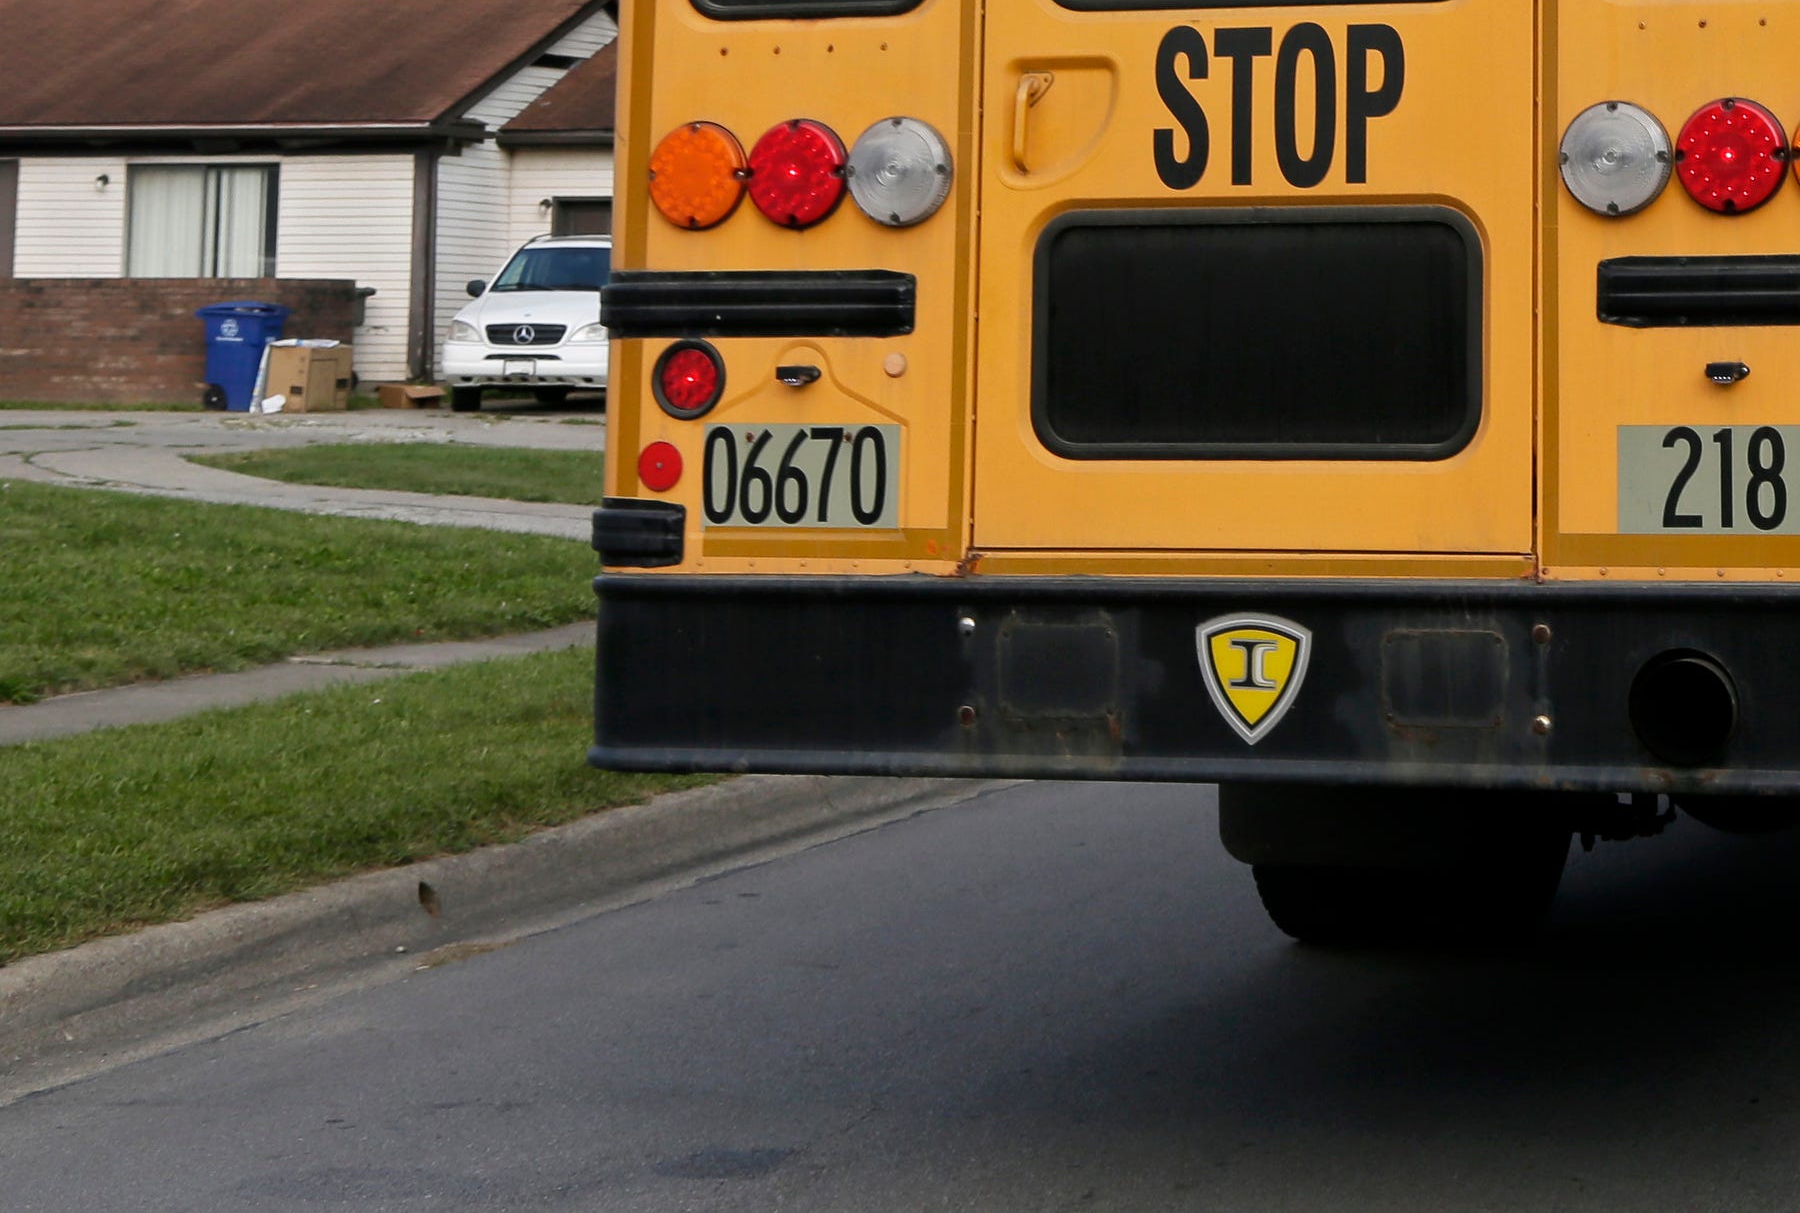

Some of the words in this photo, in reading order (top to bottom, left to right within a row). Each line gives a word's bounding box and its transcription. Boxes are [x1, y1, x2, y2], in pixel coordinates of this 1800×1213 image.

[1153, 22, 1406, 191] STOP
[702, 425, 887, 526] 06670
[1661, 426, 1788, 531] 218
